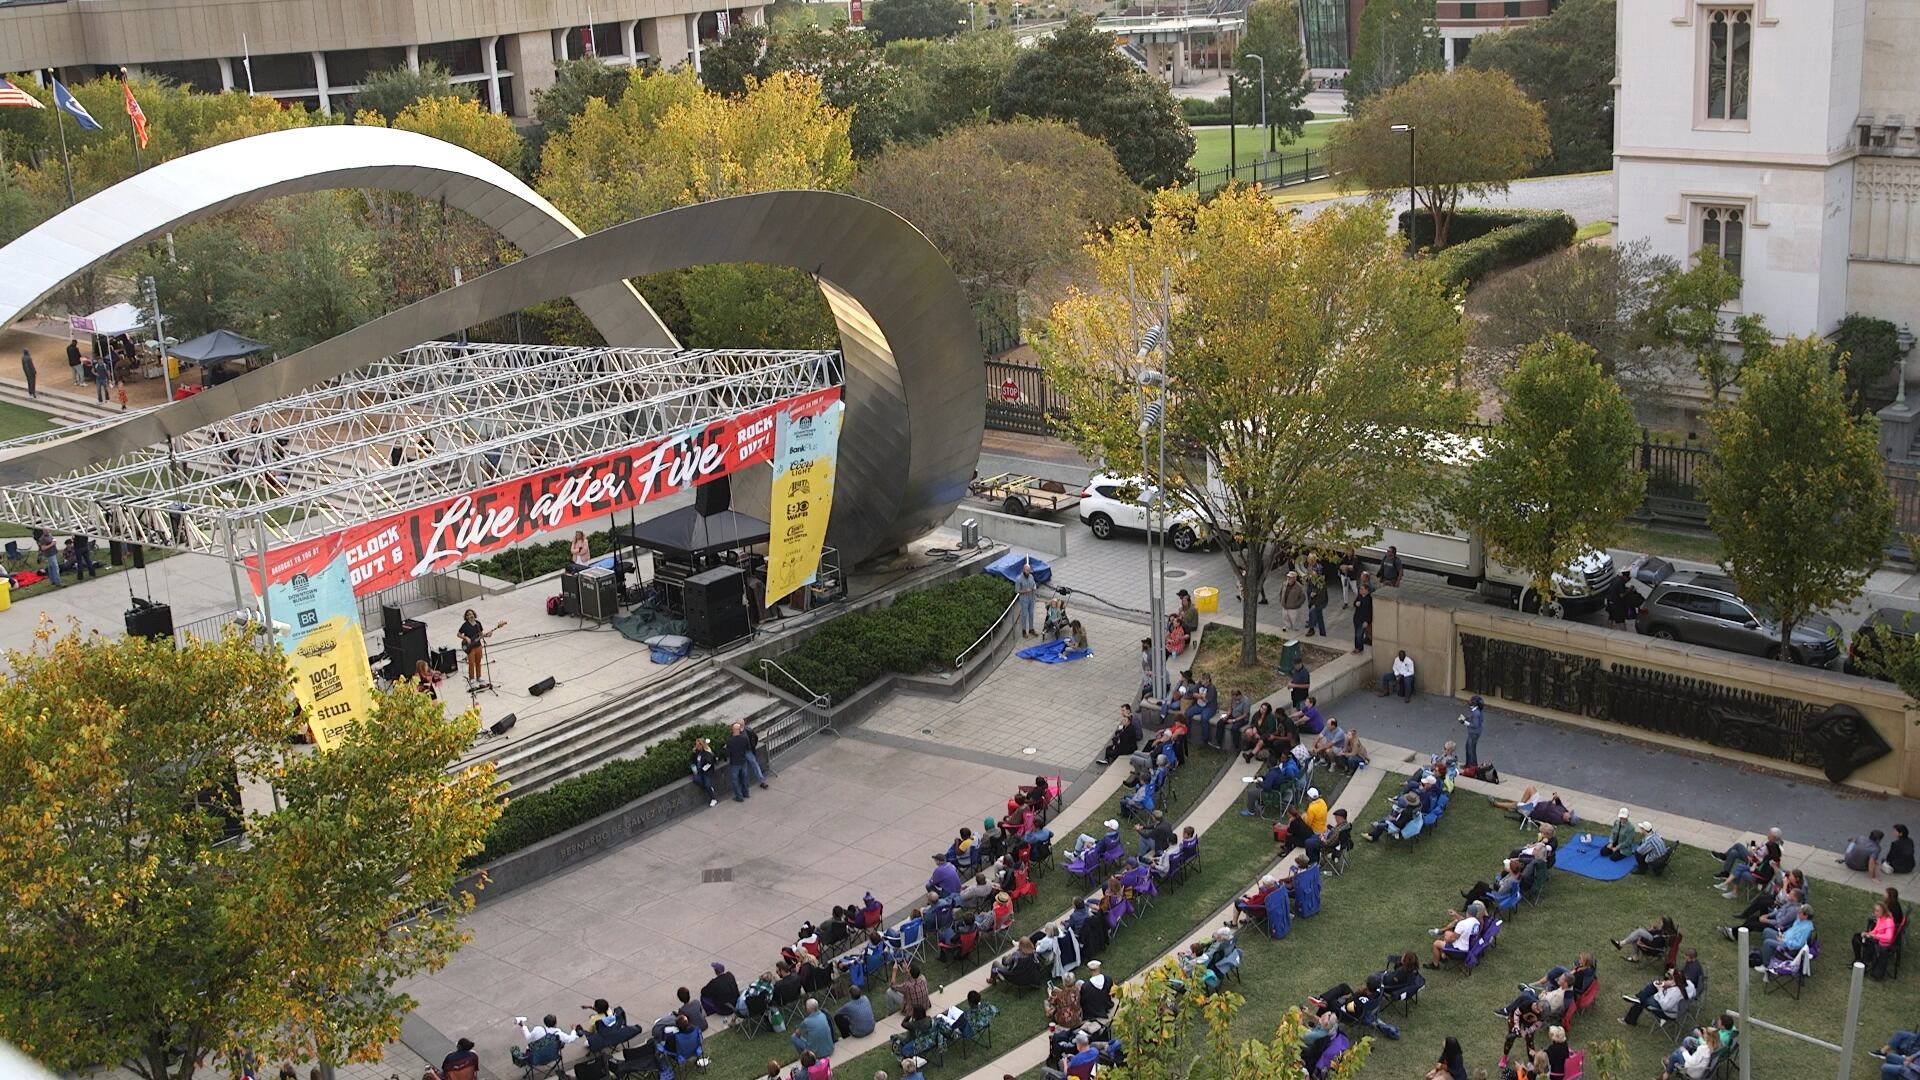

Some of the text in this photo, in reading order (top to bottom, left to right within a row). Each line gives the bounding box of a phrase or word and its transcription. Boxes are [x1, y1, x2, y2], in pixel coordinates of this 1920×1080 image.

[1003, 387, 1018, 397] STOP
[737, 414, 774, 444] ROCK
[739, 432, 770, 461] OUT!
[791, 467, 811, 477] LIGHT
[410, 434, 732, 577] Live after Five
[346, 525, 400, 566] CLOCK
[350, 546, 403, 587] OUT &
[301, 611, 316, 625] BR
[312, 682, 324, 692] THE
[324, 675, 341, 686] TIGER
[317, 701, 351, 721] stun
[560, 831, 609, 858] BERNARDO
[611, 824, 622, 834] DE
